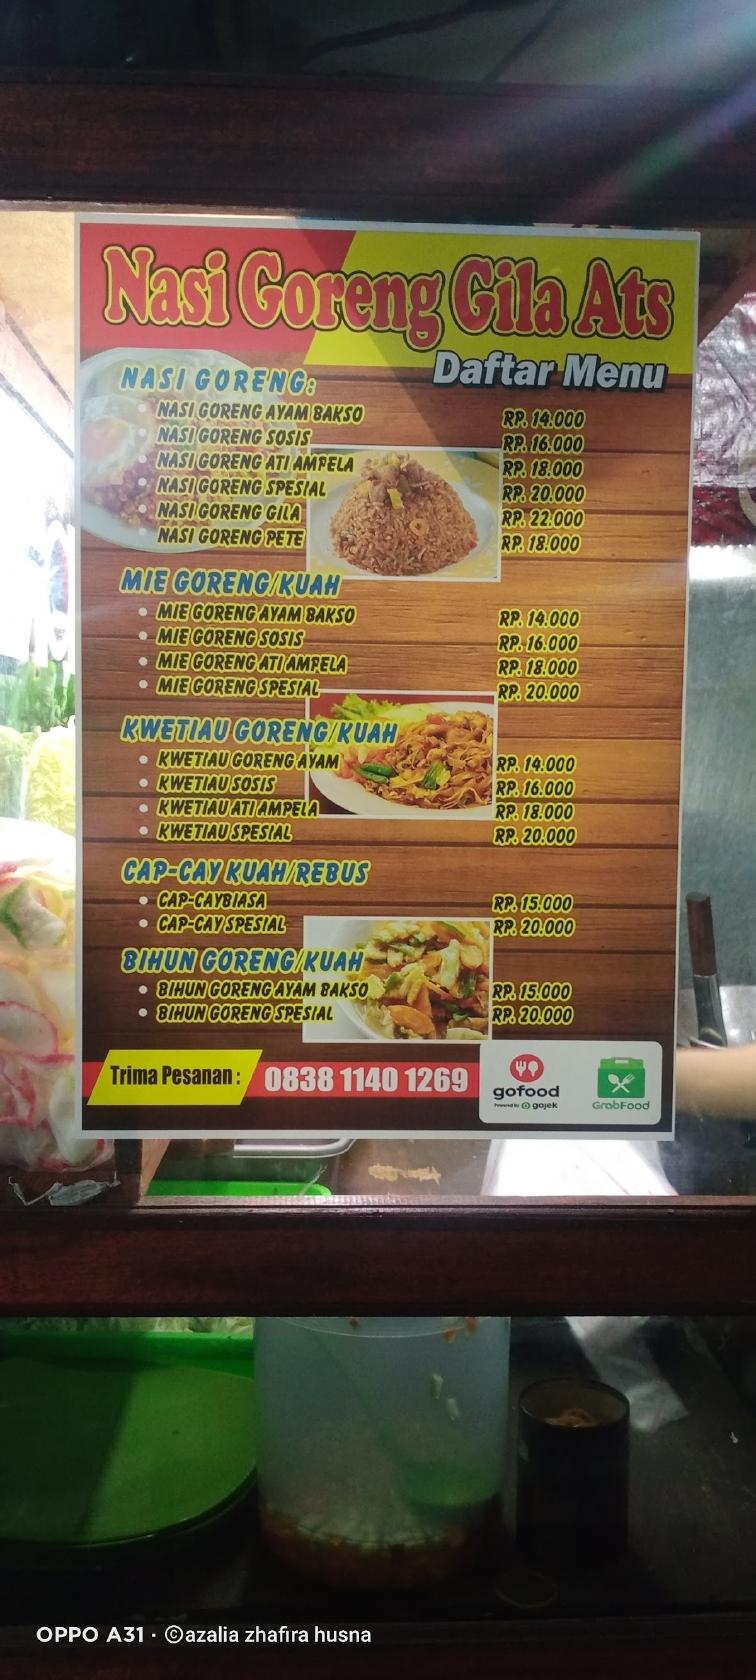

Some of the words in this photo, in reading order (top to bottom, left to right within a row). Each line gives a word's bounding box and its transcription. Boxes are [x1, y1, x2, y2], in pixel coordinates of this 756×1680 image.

[102, 245, 231, 327] Nasi
[239, 250, 444, 351] Goreng
[450, 254, 568, 337] Gila
[573, 257, 674, 339] Ats
[432, 350, 556, 387] Daftar
[562, 353, 668, 390] Menu
[121, 367, 185, 390] NASI
[195, 368, 316, 394] GORENG:
[156, 401, 195, 419] NASI
[198, 402, 263, 421] GORENG
[265, 404, 310, 421] AYAM
[312, 405, 364, 423] BAKSO
[503, 410, 527, 427] RP.
[532, 410, 585, 428] 14.000
[156, 426, 195, 444] NASI
[198, 427, 263, 446] GORENG
[265, 429, 311, 447] SOSIS
[502, 435, 527, 452] RP.
[531, 435, 584, 453] 16.000
[156, 452, 195, 469] NASI
[198, 452, 263, 472] GORENG
[265, 455, 292, 470] ATI
[292, 455, 355, 473] AMPELA
[502, 460, 526, 477] RP.
[531, 460, 583, 477] 18.000
[156, 477, 195, 494] NASI
[198, 478, 263, 497] GORENG
[265, 480, 327, 497] SPESIAL
[501, 485, 525, 502] RP.
[530, 485, 585, 502] 20.000
[156, 502, 195, 519] NASI
[198, 503, 263, 522] GORENG
[265, 504, 301, 522] GILA
[501, 509, 525, 527] RP.
[530, 510, 584, 527] 22.000
[156, 527, 195, 544] NASI
[198, 527, 263, 547] GORENG
[265, 529, 305, 547] PETE
[500, 535, 523, 552] RP.
[528, 535, 581, 552] 18.000
[120, 569, 169, 593] MIE
[174, 570, 342, 597] GORENG/KUAH
[157, 603, 190, 621] MIE
[192, 604, 257, 623] GORENG
[258, 606, 302, 623] AYAM
[305, 606, 356, 625] BAKSO
[499, 610, 523, 627] RP.
[527, 610, 580, 627] 14.000
[157, 628, 190, 645] MIE
[192, 629, 257, 648] GORENG
[259, 630, 305, 648] SOSIS
[498, 635, 522, 652] RP.
[526, 635, 579, 652] 16.000
[157, 653, 190, 670] MIE
[192, 654, 257, 672] GORENG
[258, 655, 286, 671] ATI
[285, 655, 347, 673] AMPELA
[497, 659, 521, 676] RP.
[526, 659, 578, 676] 18.000
[157, 677, 190, 695] MIE
[192, 678, 257, 697] GORENG
[259, 679, 320, 697] SPESIAL
[497, 683, 521, 700] RP.
[525, 683, 580, 700] 20.000
[121, 717, 230, 742] KWETIAU
[234, 719, 399, 745] GORENG/KUAH
[157, 750, 229, 769] KWETIAU
[231, 752, 296, 770] GORENG
[297, 753, 340, 770] AYAM
[496, 756, 519, 773] RP.
[524, 756, 576, 772] 14.000
[157, 775, 229, 792] KWETIAU
[231, 776, 276, 793] SOSIS
[495, 780, 519, 796] RP.
[524, 780, 574, 796] 16.000
[157, 799, 229, 816] KWETIAU
[231, 800, 255, 816] ATI
[257, 800, 319, 818] AMPELA
[495, 804, 518, 820] RP.
[523, 804, 574, 820] 18.000
[157, 823, 229, 841] KWETIAU
[231, 824, 292, 841] SPESIAL
[494, 828, 518, 844] RP.
[522, 827, 576, 844] 20.000
[123, 859, 223, 883] CAP-CAY
[226, 861, 370, 885] KUAH/REBUS
[493, 895, 517, 912] RP.
[521, 895, 573, 911] 15.000
[157, 916, 227, 933] CAP-CAY
[226, 916, 286, 933] SPESIAL
[493, 919, 517, 936] RP.
[521, 919, 575, 935] 20.000
[122, 949, 197, 972] BIHUN
[201, 950, 365, 973] GORENG/KUAH
[157, 981, 208, 998] BIHUN
[209, 981, 273, 999] GORENG
[274, 981, 316, 998] AYAM
[319, 982, 369, 998] BAKSO
[492, 983, 515, 1000] RP.
[520, 983, 571, 1000] 15.000
[157, 1005, 208, 1021] BIHUN
[209, 1006, 272, 1023] GORENG
[274, 1005, 334, 1022] SPESIAL
[491, 1007, 515, 1023] RP.
[519, 1007, 573, 1023] 20.000
[109, 1064, 159, 1087] Trima
[161, 1065, 233, 1087] Pesanan
[263, 1065, 335, 1093] 0838
[338, 1066, 399, 1092] 1140
[403, 1066, 469, 1093] 1269
[493, 1085, 559, 1100] gofood
[532, 1102, 558, 1110] gojek
[592, 1101, 650, 1110] GrabFood
